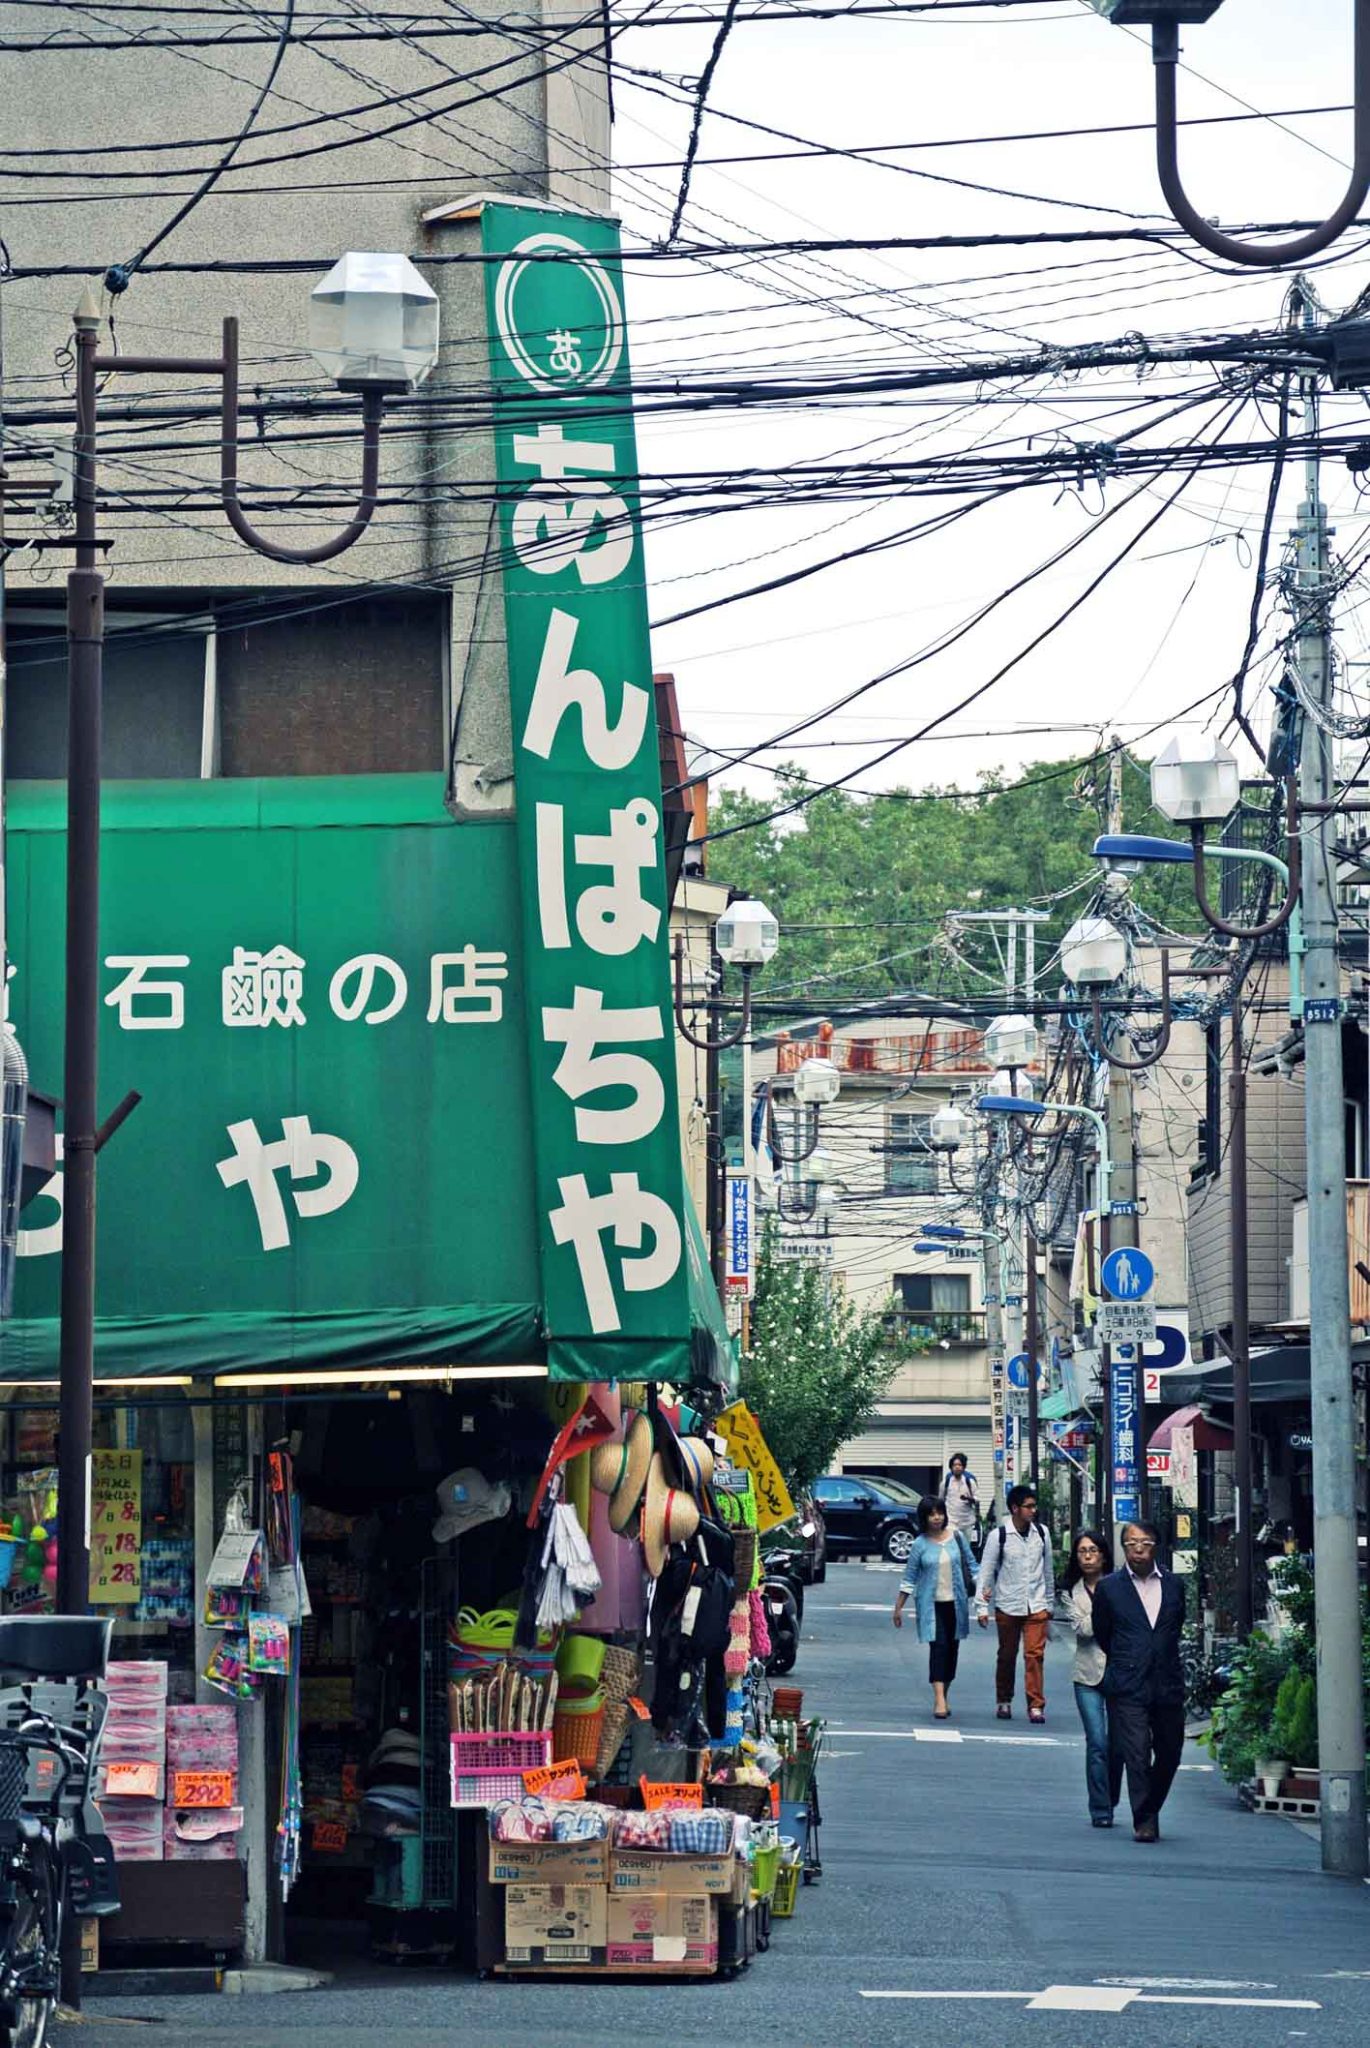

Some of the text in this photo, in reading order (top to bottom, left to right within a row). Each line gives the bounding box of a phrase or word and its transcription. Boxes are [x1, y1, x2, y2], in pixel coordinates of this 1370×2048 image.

[512, 423, 682, 1334] あんぱちや
[1117, 1365, 1135, 1465] ニコライ歯科
